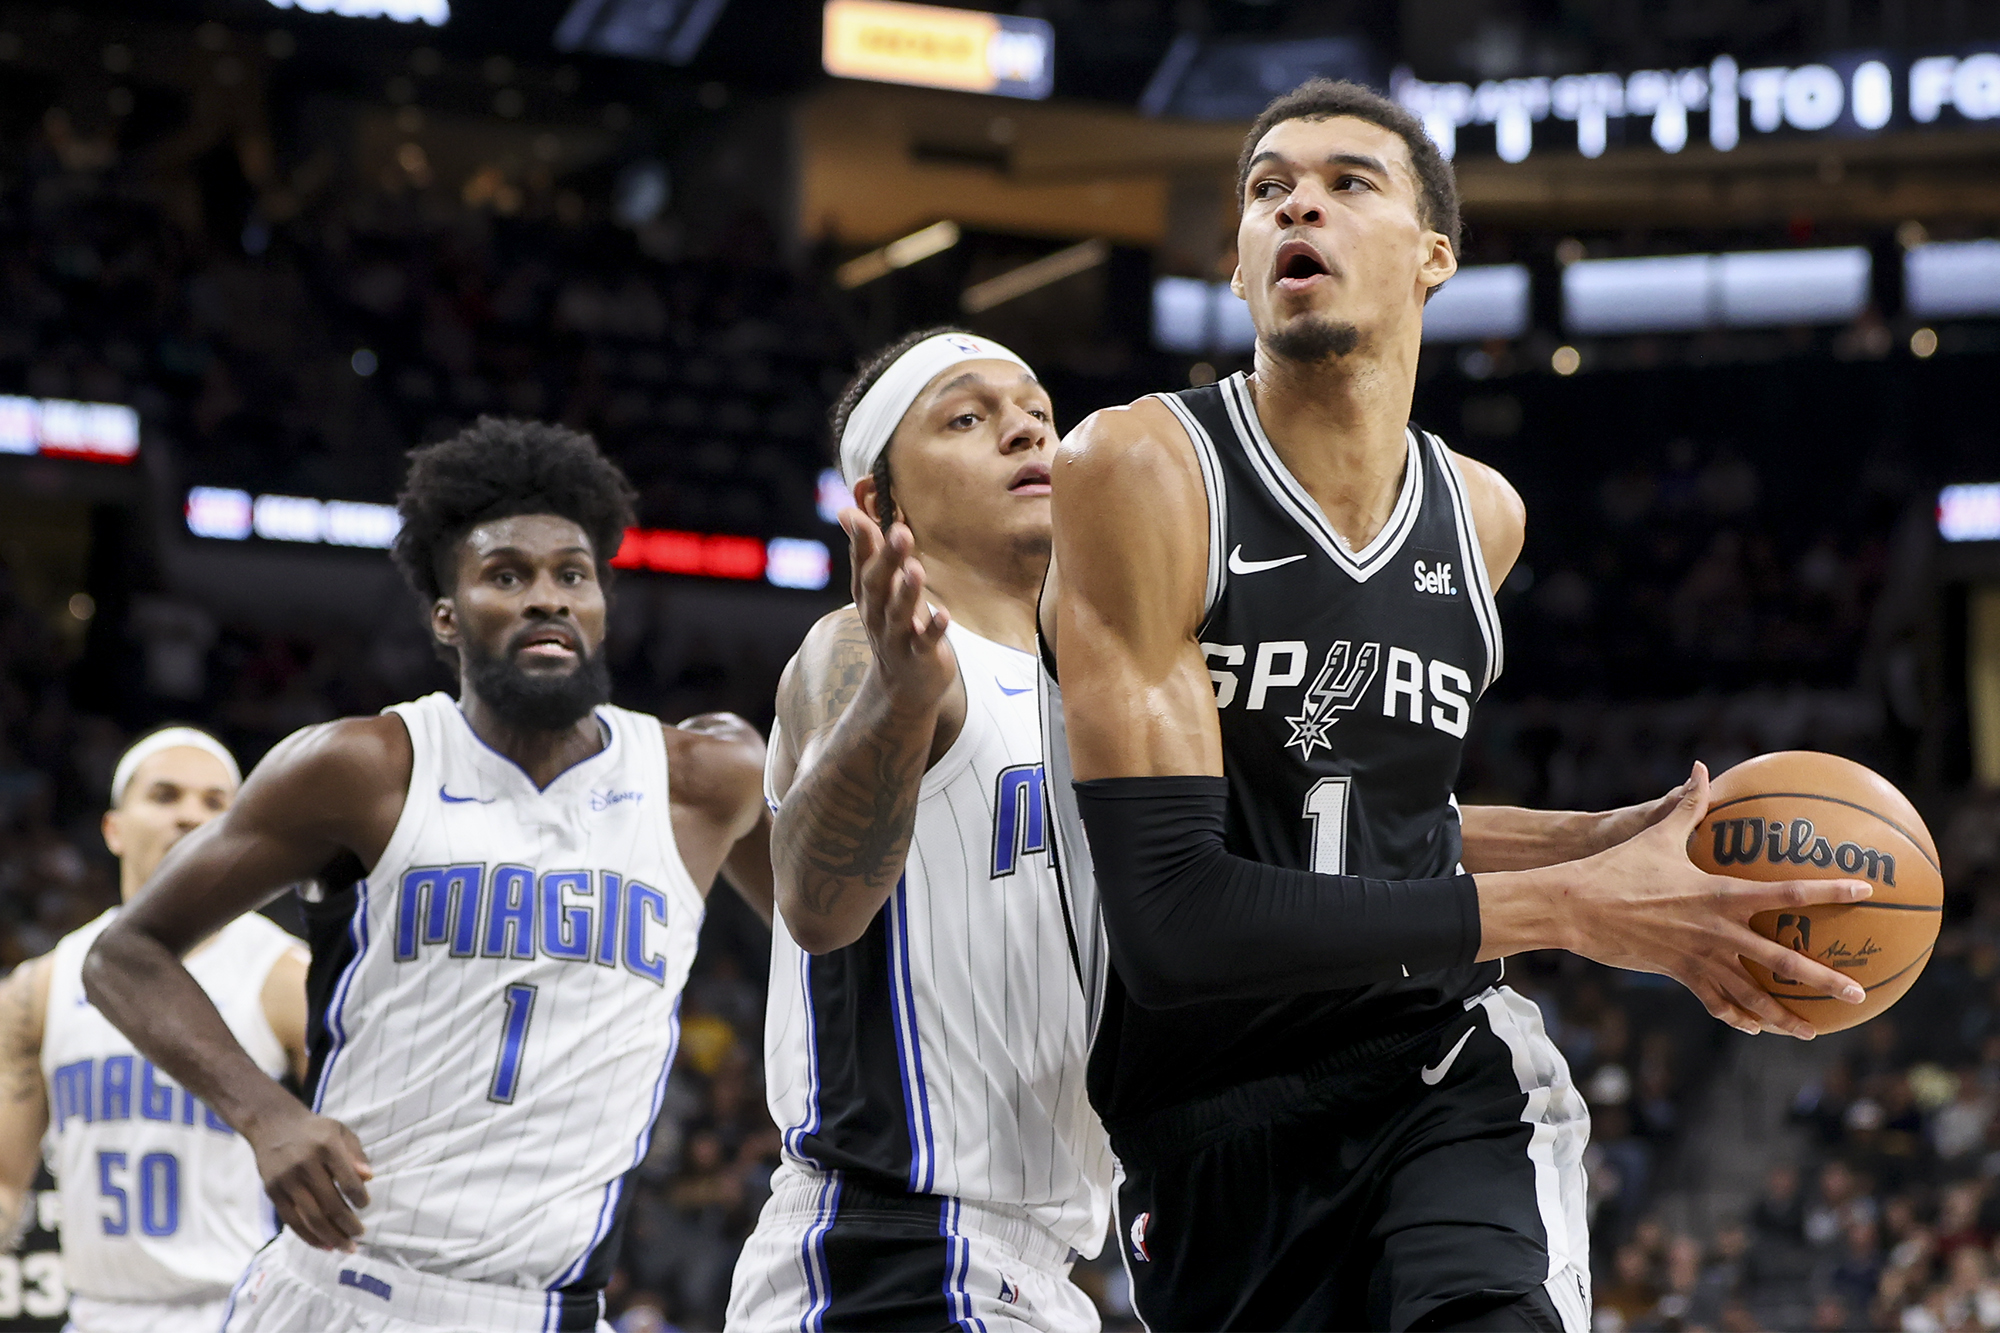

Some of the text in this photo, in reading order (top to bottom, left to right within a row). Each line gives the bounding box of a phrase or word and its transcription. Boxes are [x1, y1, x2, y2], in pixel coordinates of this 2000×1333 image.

[1740, 64, 1843, 131] TO
[1414, 560, 1457, 595] Self.
[1200, 641, 1471, 745] SPURS
[588, 788, 644, 812] Disney
[1302, 776, 1351, 877] 1
[1711, 817, 1896, 888] Wilson
[393, 862, 668, 988] MAGIC
[487, 982, 538, 1105] 1
[98, 1151, 180, 1237] 50
